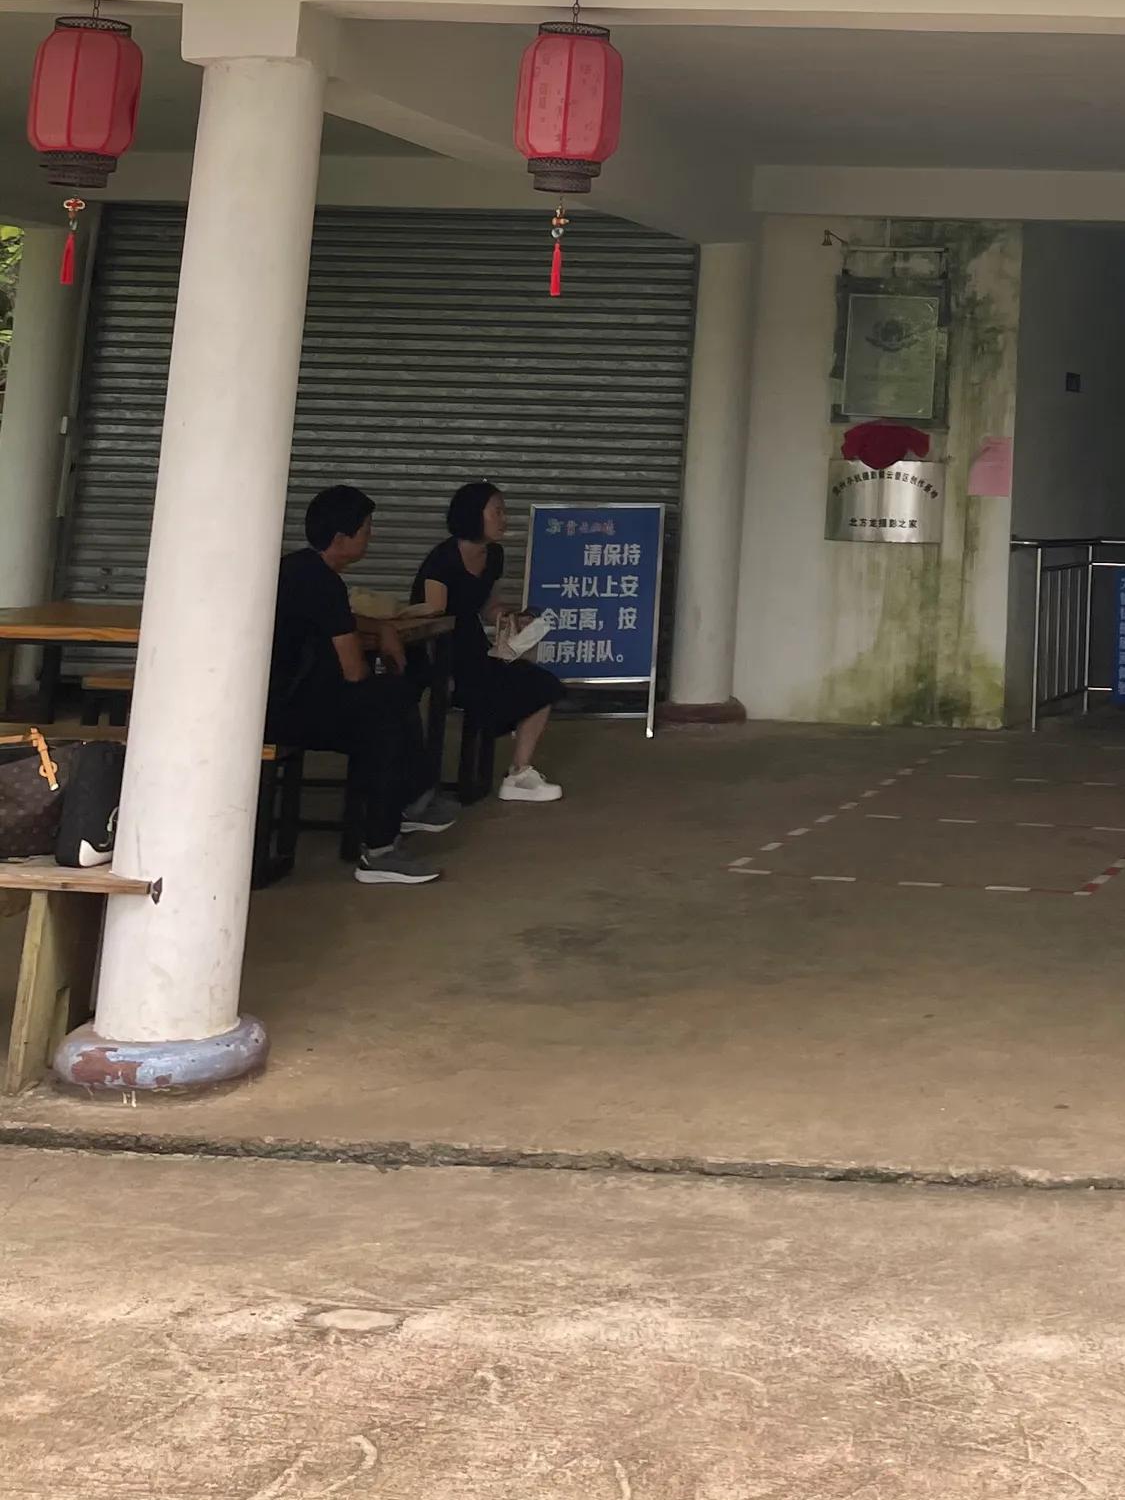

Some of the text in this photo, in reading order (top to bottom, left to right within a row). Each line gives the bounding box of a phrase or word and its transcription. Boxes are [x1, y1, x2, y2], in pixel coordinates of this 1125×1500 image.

[583, 543, 641, 566] 请保持
[541, 575, 639, 599] 一米以上安
